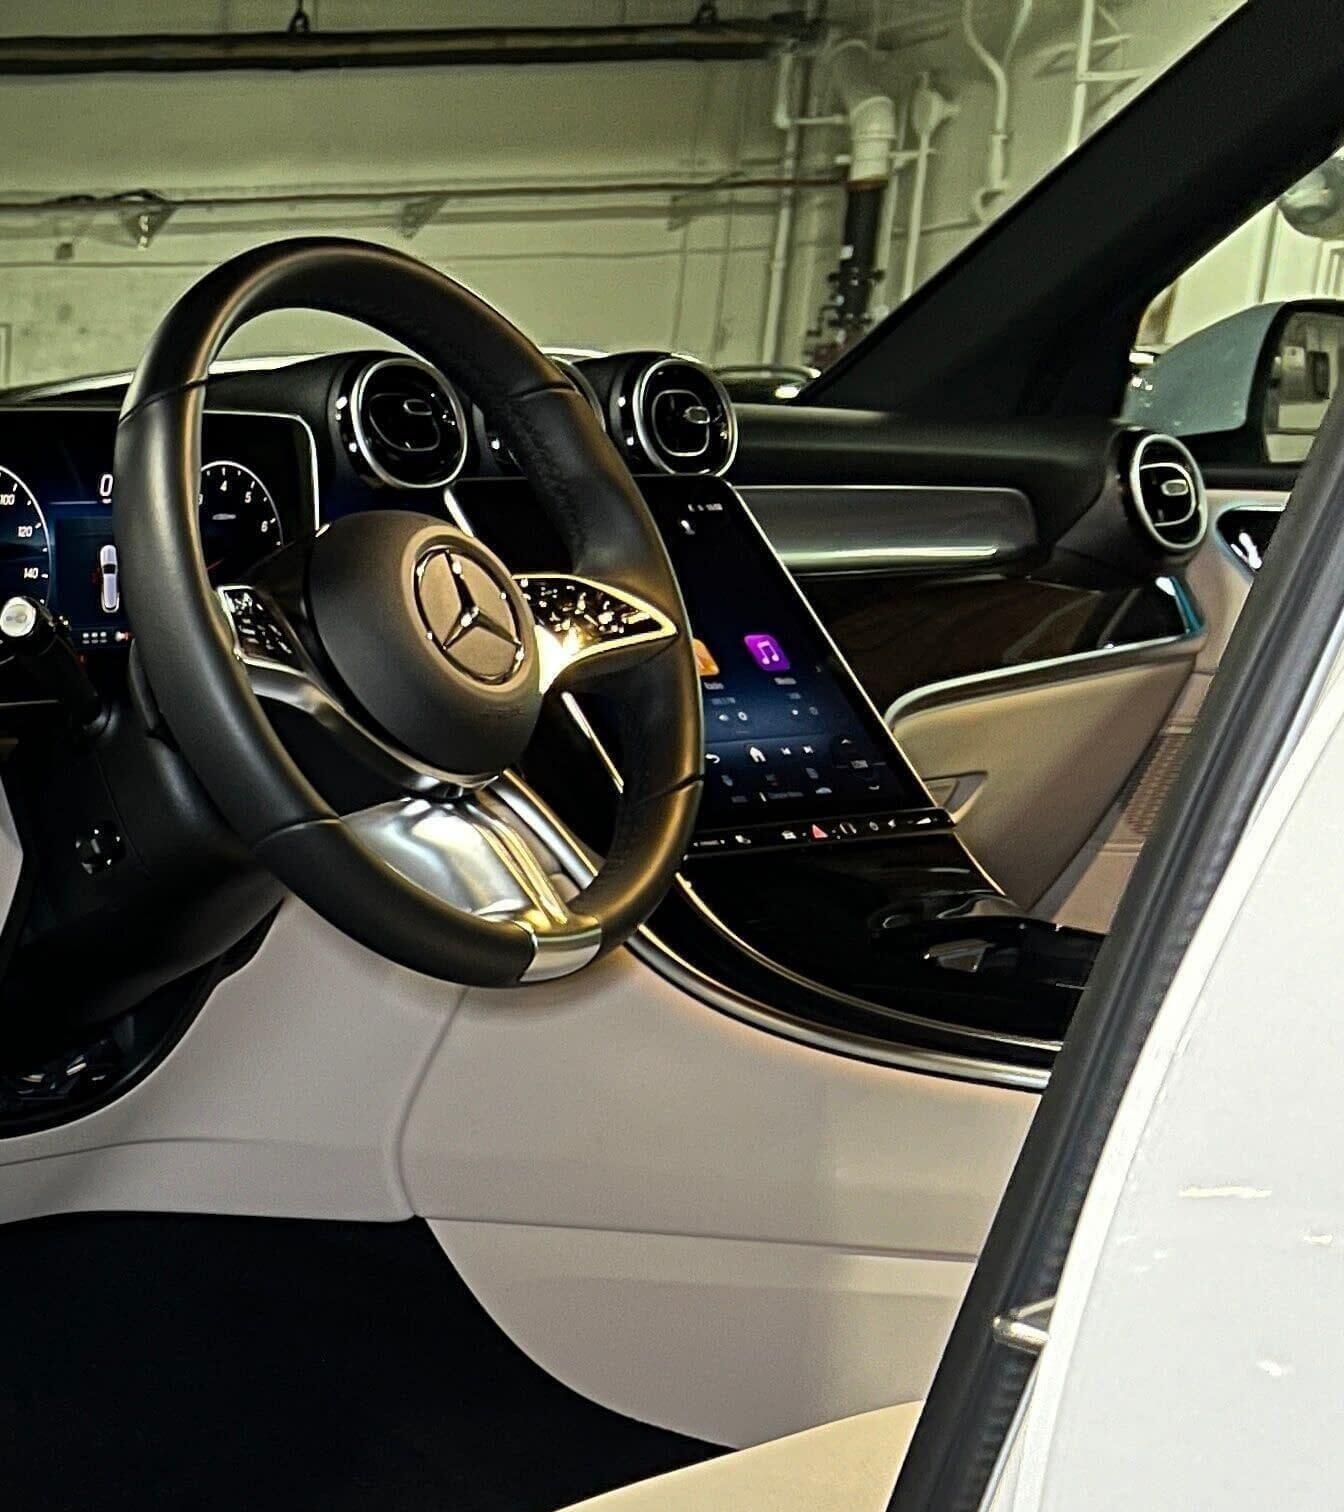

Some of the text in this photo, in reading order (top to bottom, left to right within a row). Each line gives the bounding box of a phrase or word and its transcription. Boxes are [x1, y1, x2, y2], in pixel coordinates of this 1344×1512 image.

[219, 480, 228, 491] 4
[0, 494, 15, 506] 100
[244, 491, 252, 503] 5
[18, 526, 32, 537] 120
[261, 521, 268, 532] 6
[23, 567, 38, 579] 140
